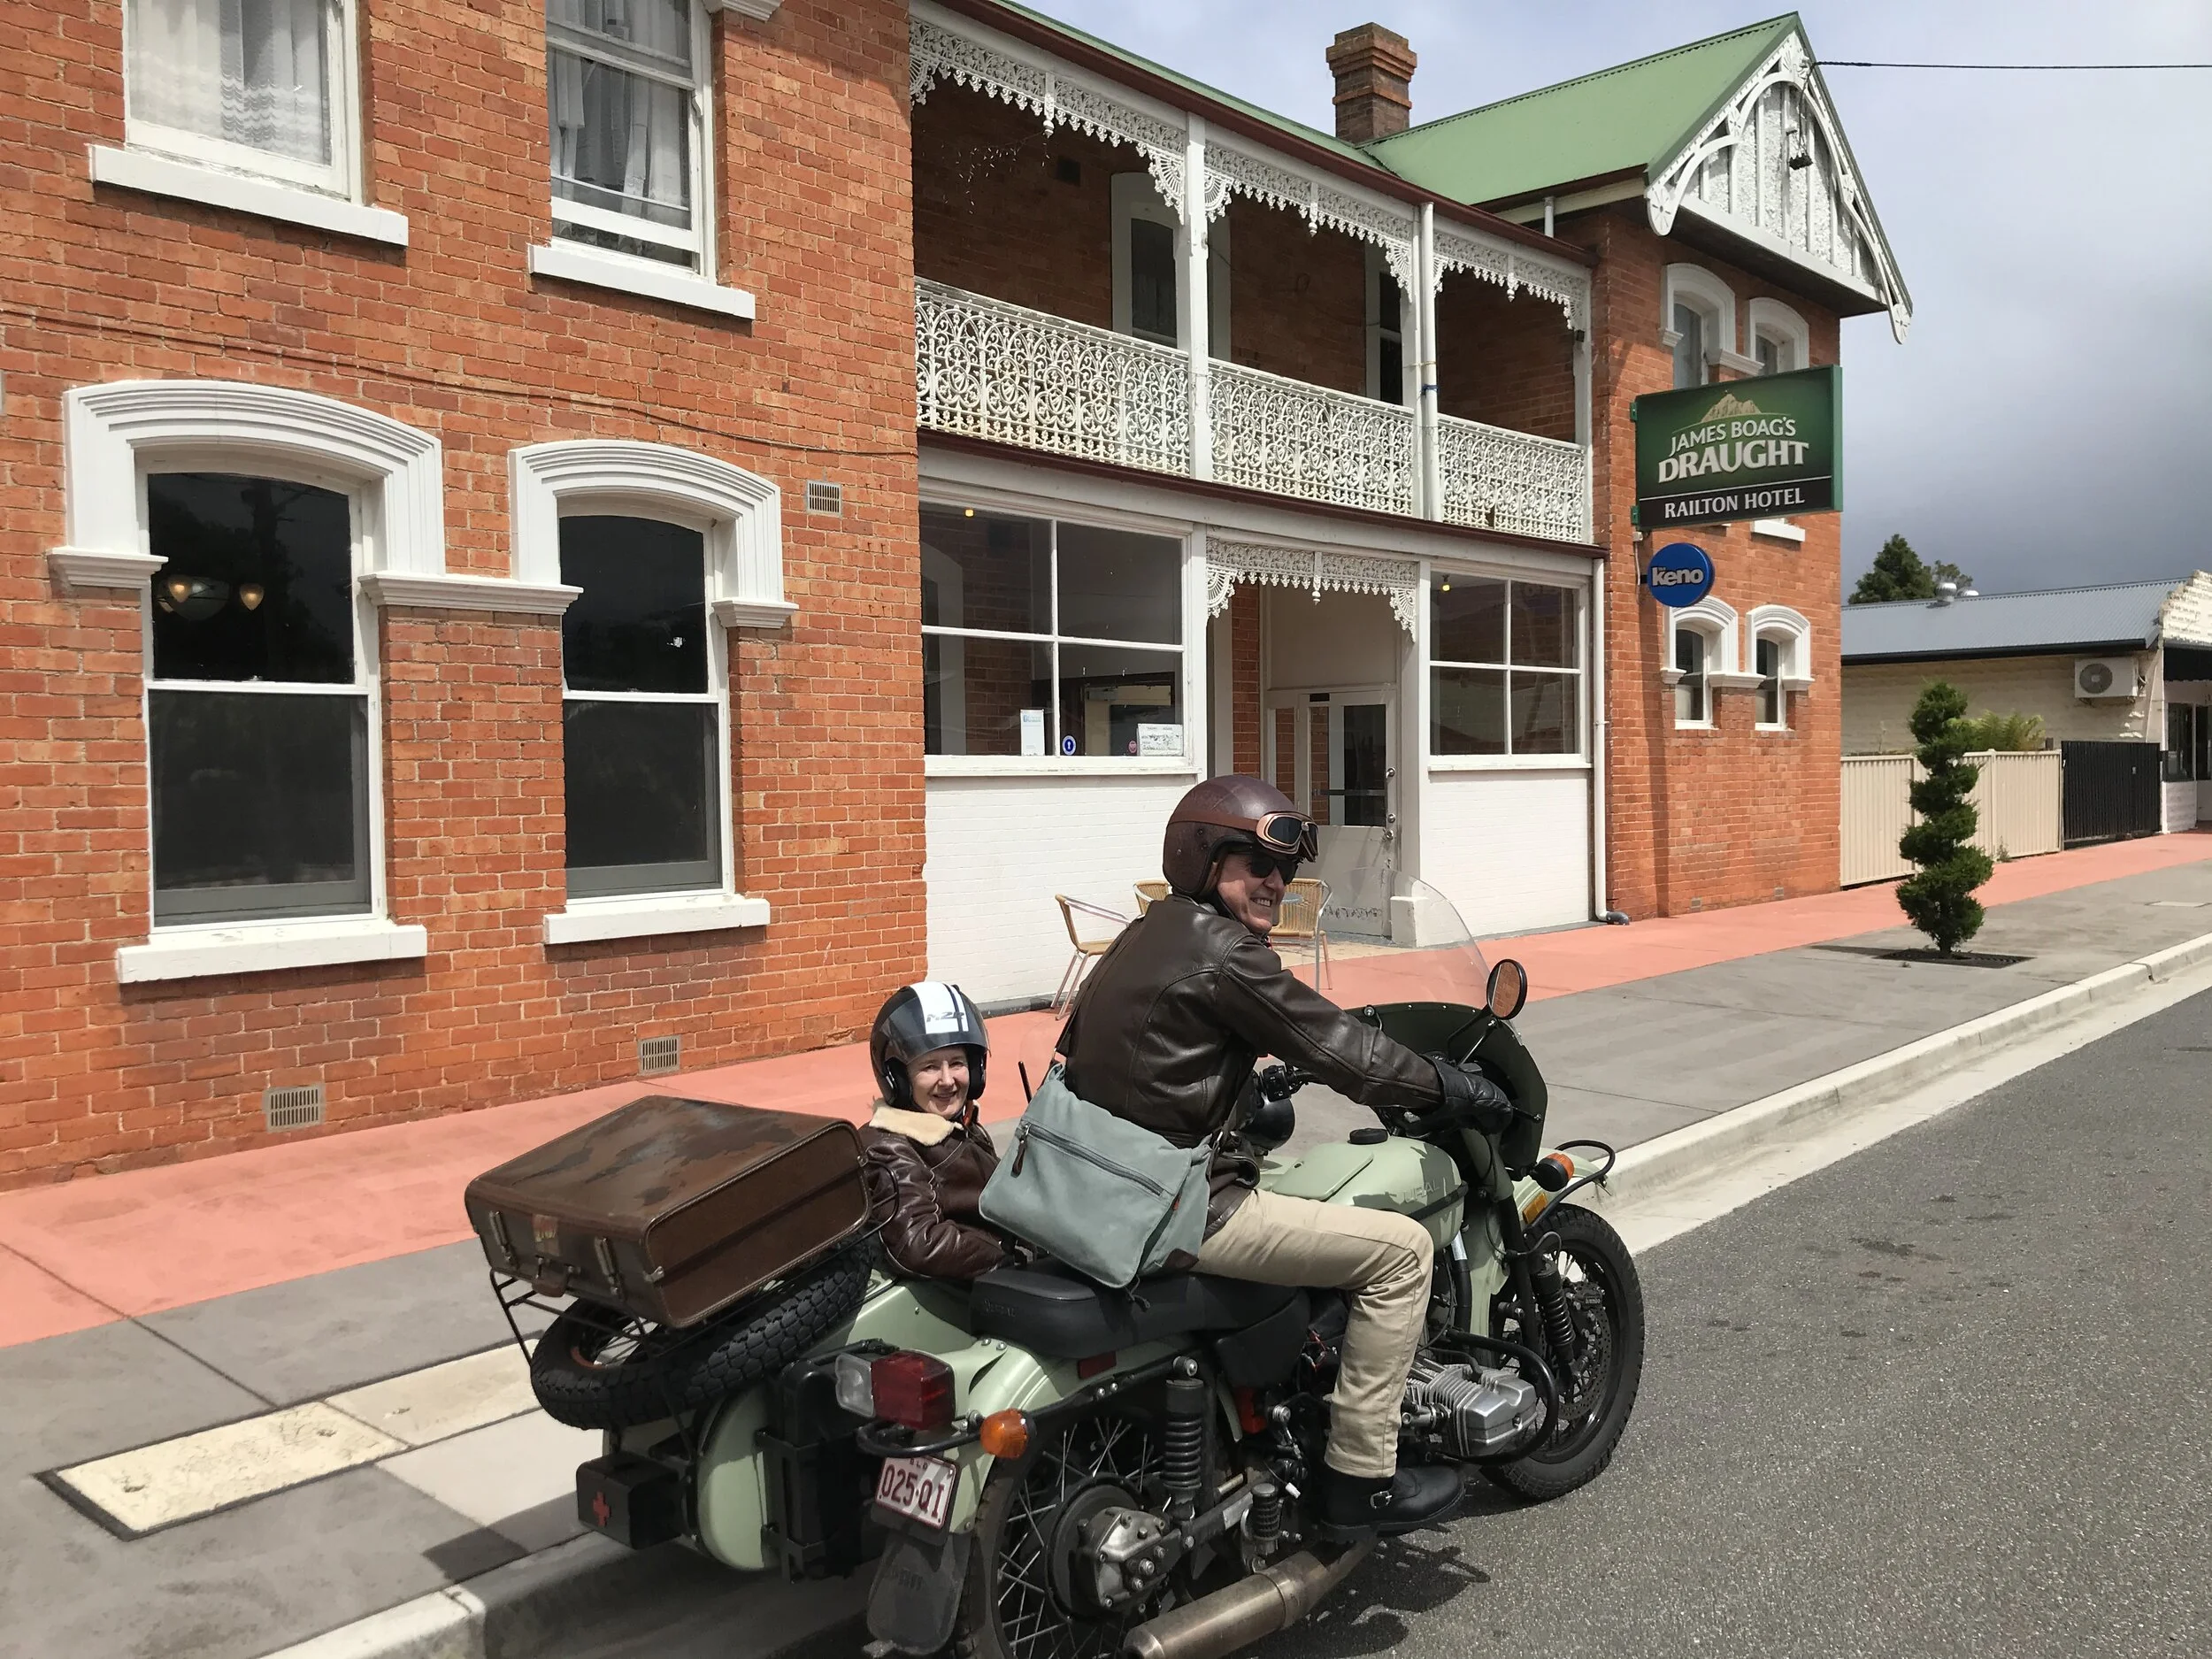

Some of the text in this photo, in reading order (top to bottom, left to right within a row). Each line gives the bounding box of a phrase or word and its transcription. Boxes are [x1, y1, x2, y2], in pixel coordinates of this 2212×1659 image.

[1669, 416, 1797, 457] JAMES BOAG'S
[1658, 439, 1810, 483] DRAUGHT
[1664, 488, 1806, 518] RAILTON HOTEL
[1652, 566, 1704, 586] keno
